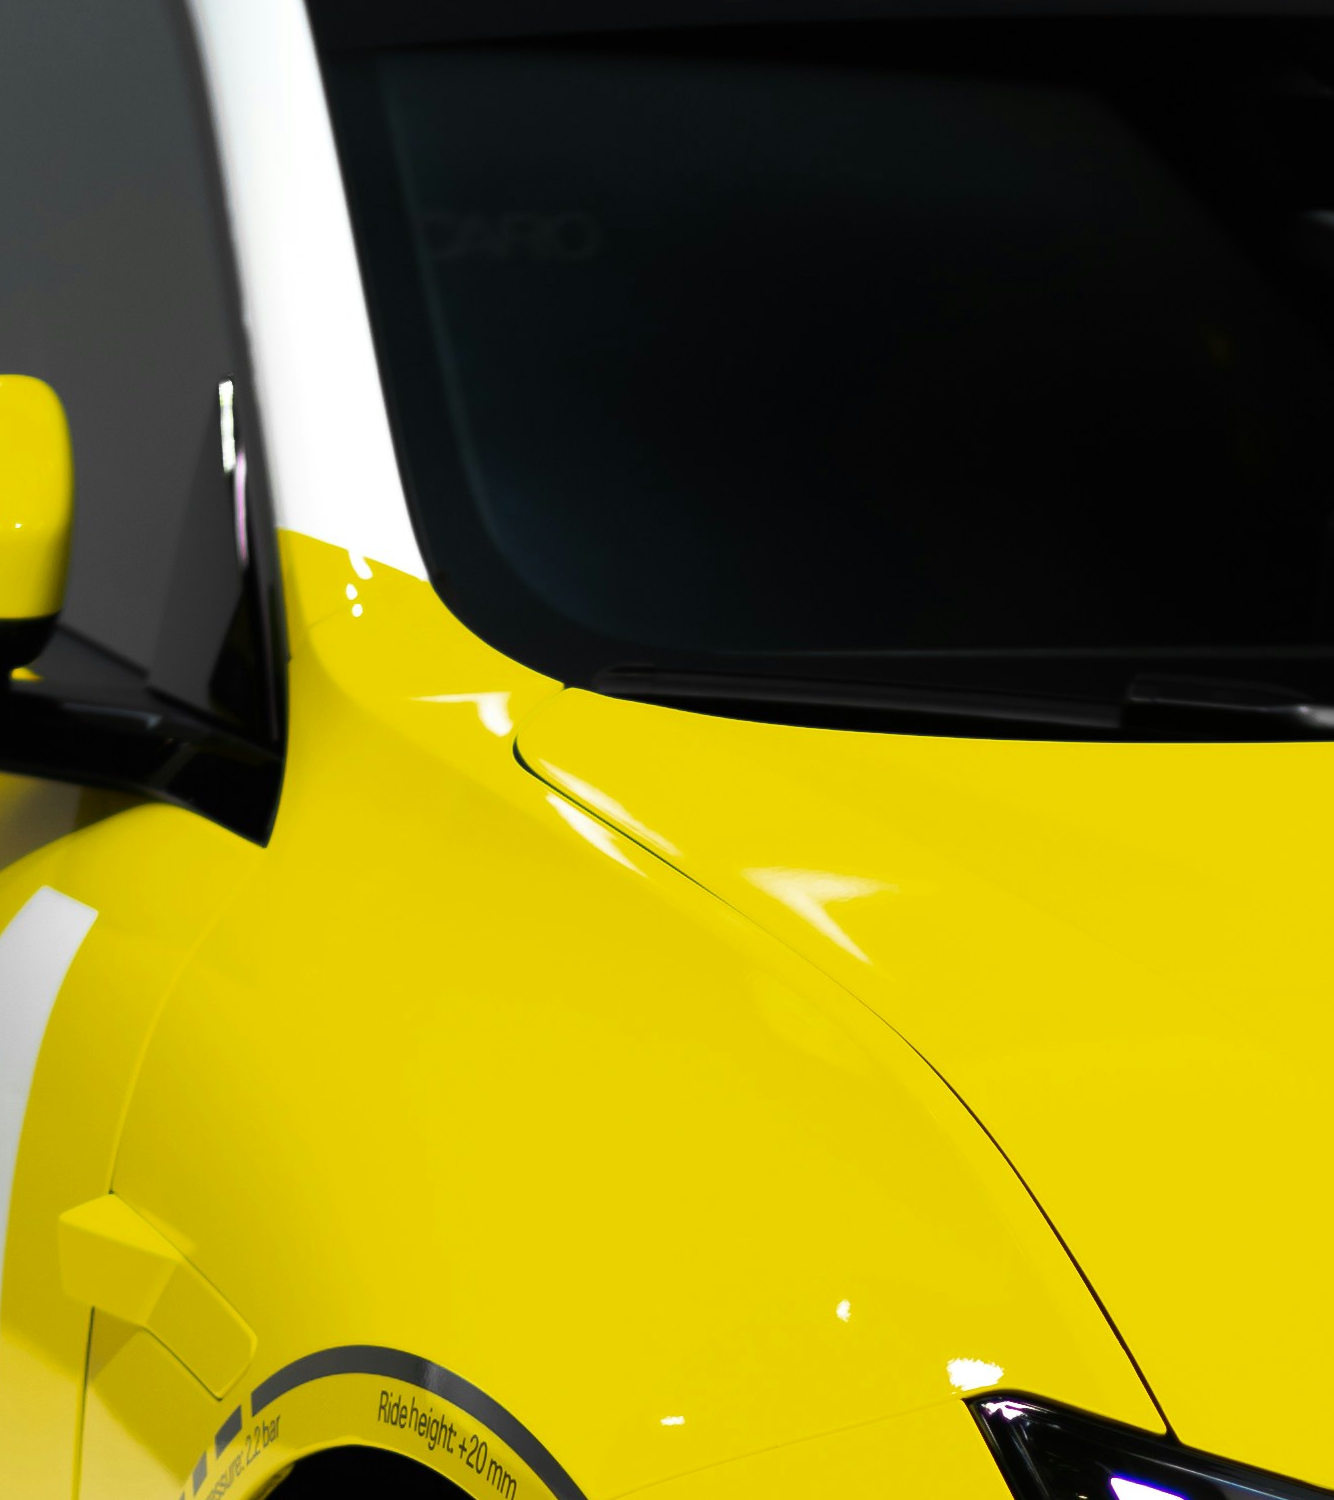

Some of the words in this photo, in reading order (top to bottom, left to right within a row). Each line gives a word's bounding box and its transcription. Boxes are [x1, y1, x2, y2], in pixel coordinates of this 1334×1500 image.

[262, 1414, 281, 1448] bar
[377, 1390, 408, 1430] Ride
[408, 1396, 457, 1454] height:
[458, 1434, 488, 1475] +20
